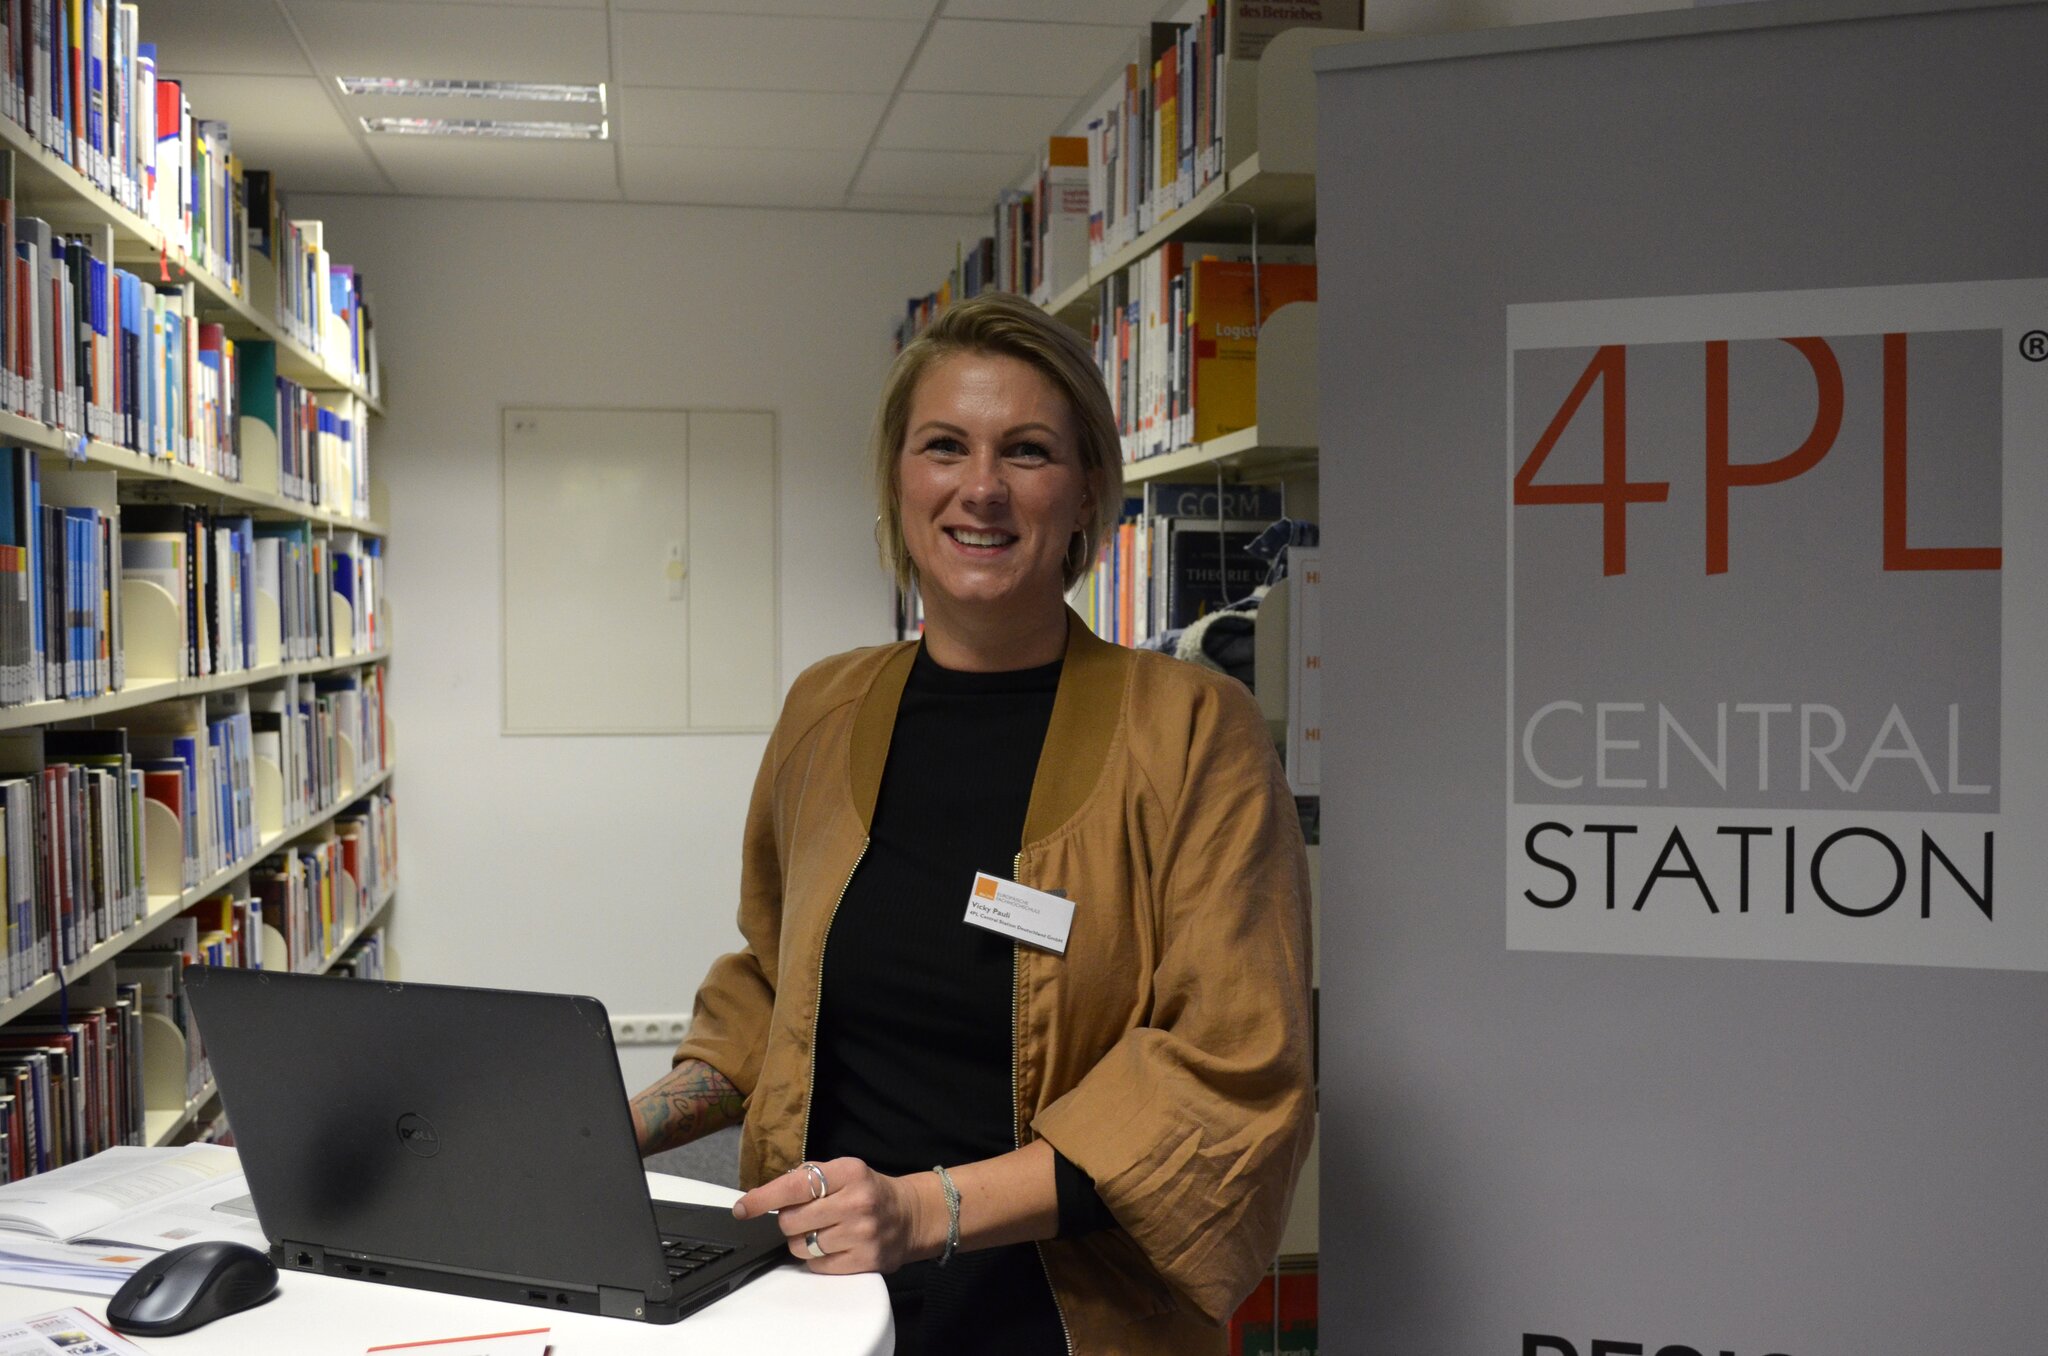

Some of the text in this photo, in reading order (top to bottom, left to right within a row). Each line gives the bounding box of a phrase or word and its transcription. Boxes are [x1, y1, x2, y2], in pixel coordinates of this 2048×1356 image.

[1513, 331, 2002, 577] 4PL
[1522, 700, 1992, 795] CENTRAL
[972, 901, 1010, 918] Vicky Pauli
[1523, 821, 1995, 922] STATION
